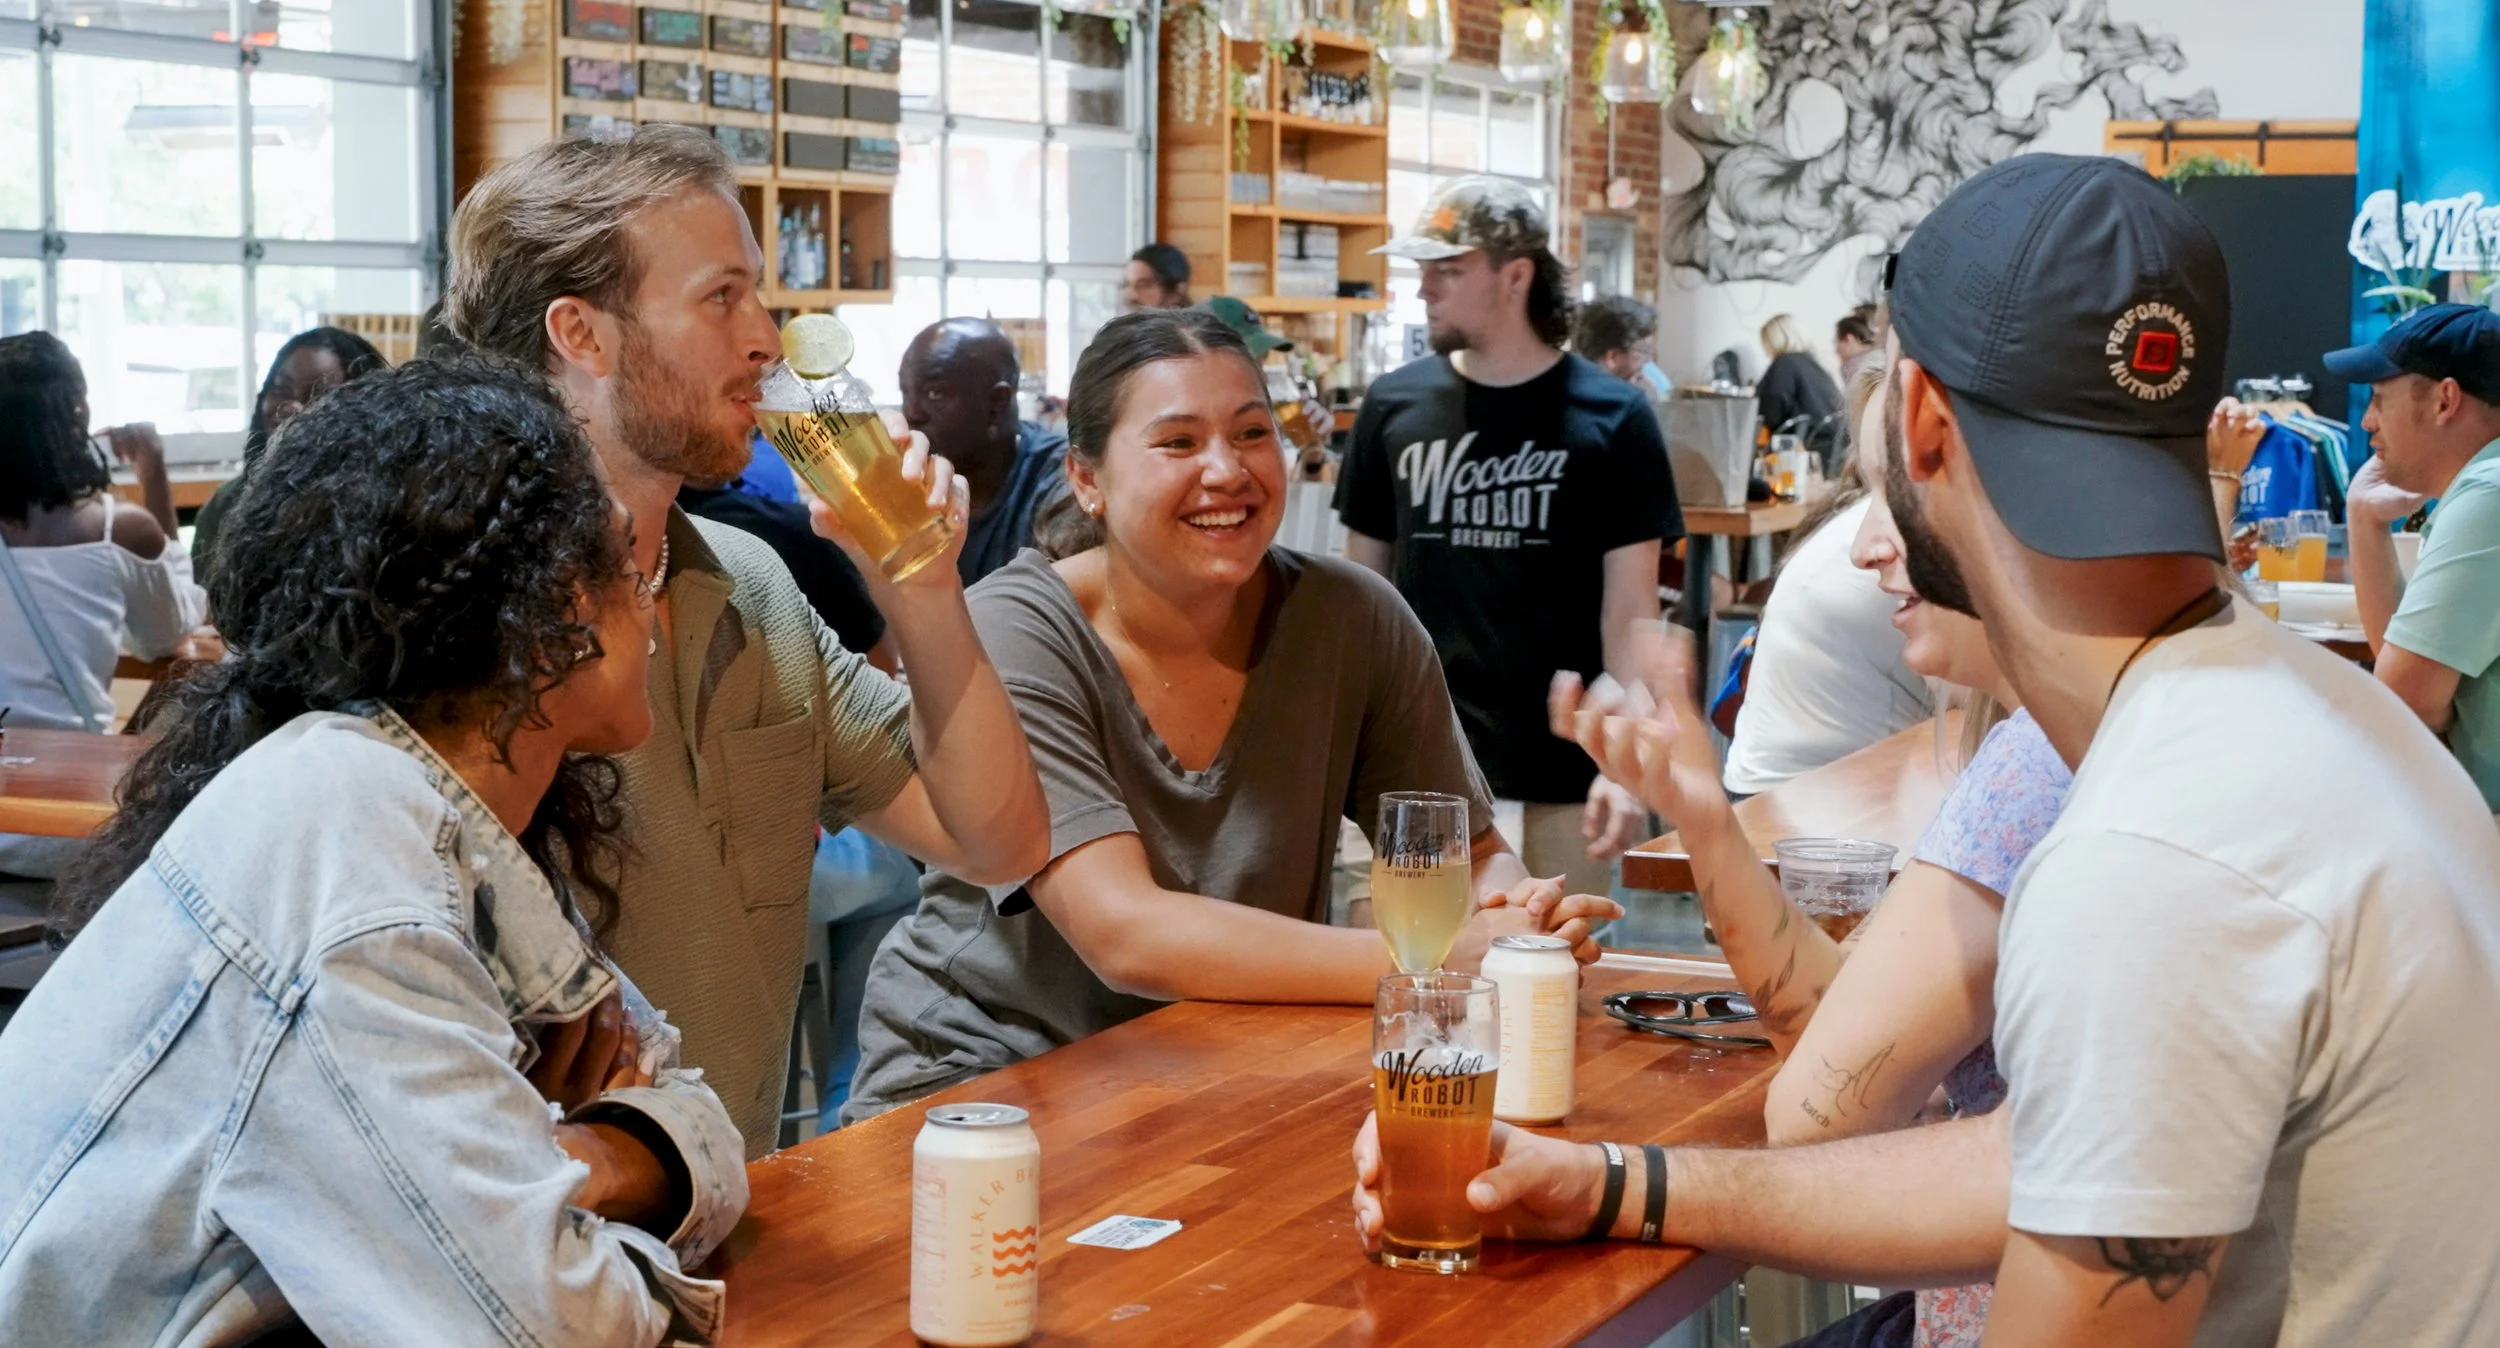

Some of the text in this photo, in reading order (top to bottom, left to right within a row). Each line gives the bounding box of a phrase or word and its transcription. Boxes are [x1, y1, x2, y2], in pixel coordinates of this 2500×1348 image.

[1412, 328, 1425, 356] 5
[2105, 302, 2195, 358] PERFORMANCE
[2109, 360, 2190, 400] NUTRITION
[774, 390, 838, 463] Wooden
[803, 405, 850, 457] ROBOT
[1397, 431, 1570, 524] Wooden
[1452, 484, 1559, 531] ROBOT
[1380, 831, 1445, 867] Wooden
[1395, 850, 1441, 869] ROBOT
[1394, 870, 1426, 879] BREWERY
[1381, 1048, 1484, 1102] Wooden
[1411, 1076, 1480, 1105] ROBOT
[1411, 1106, 1455, 1118] BREWERY
[969, 1179, 1005, 1280] WALKER
